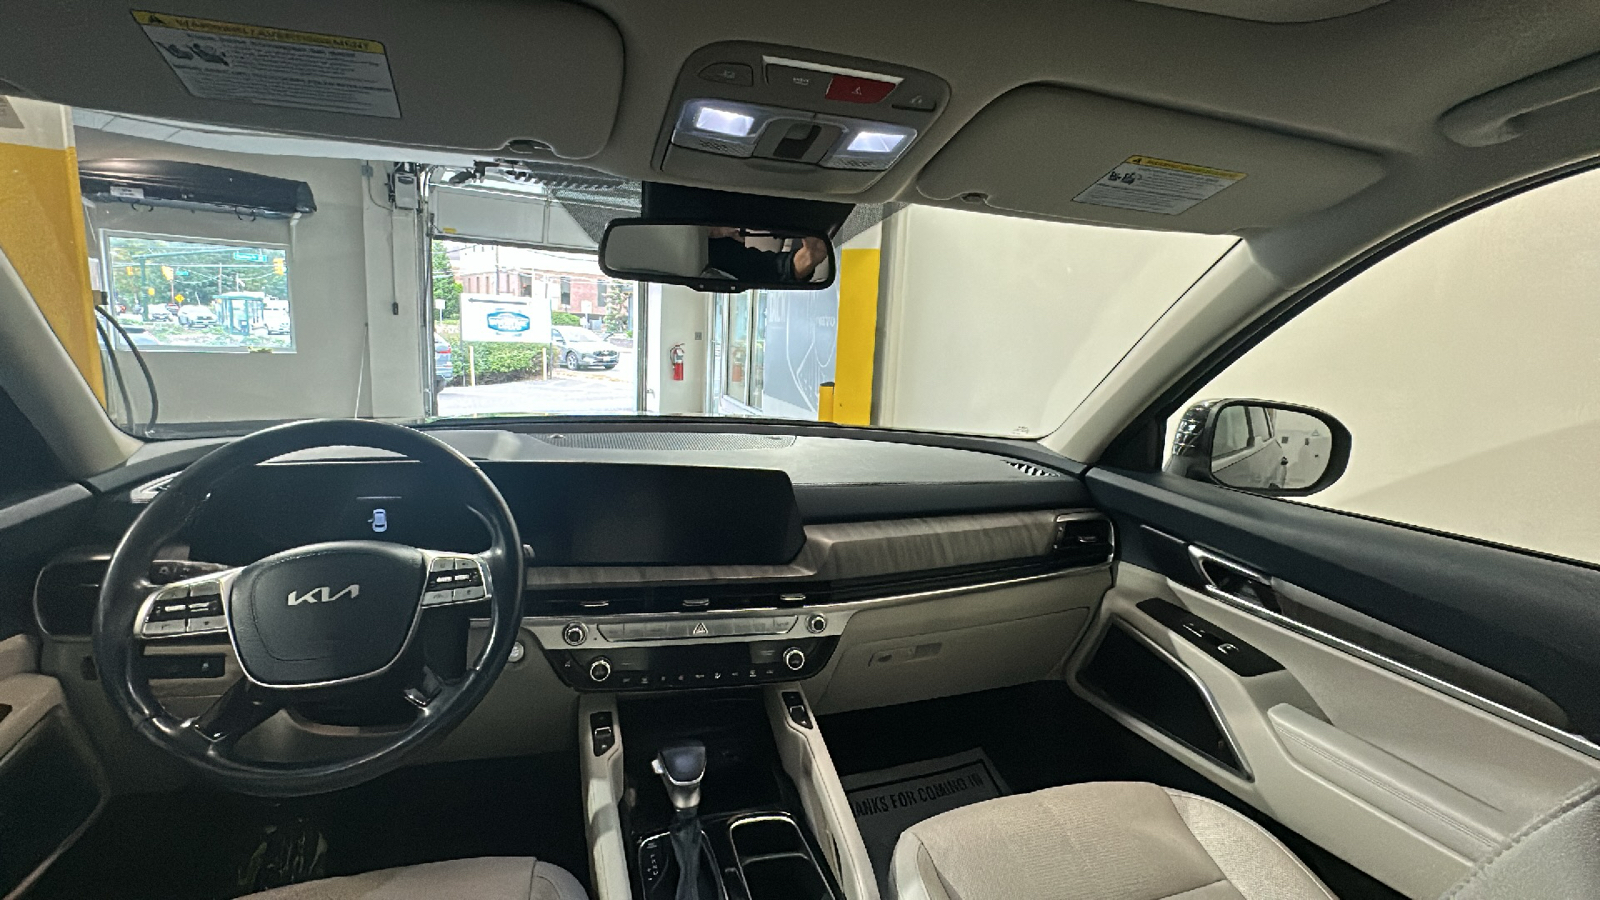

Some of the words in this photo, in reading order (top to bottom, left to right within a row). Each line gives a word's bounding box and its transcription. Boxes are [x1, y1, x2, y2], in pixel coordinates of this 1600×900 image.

[287, 584, 360, 606] KIA
[854, 795, 889, 817] ANKS
[891, 790, 918, 808] FOR
[919, 779, 967, 803] COMING
[968, 772, 984, 787] IN
